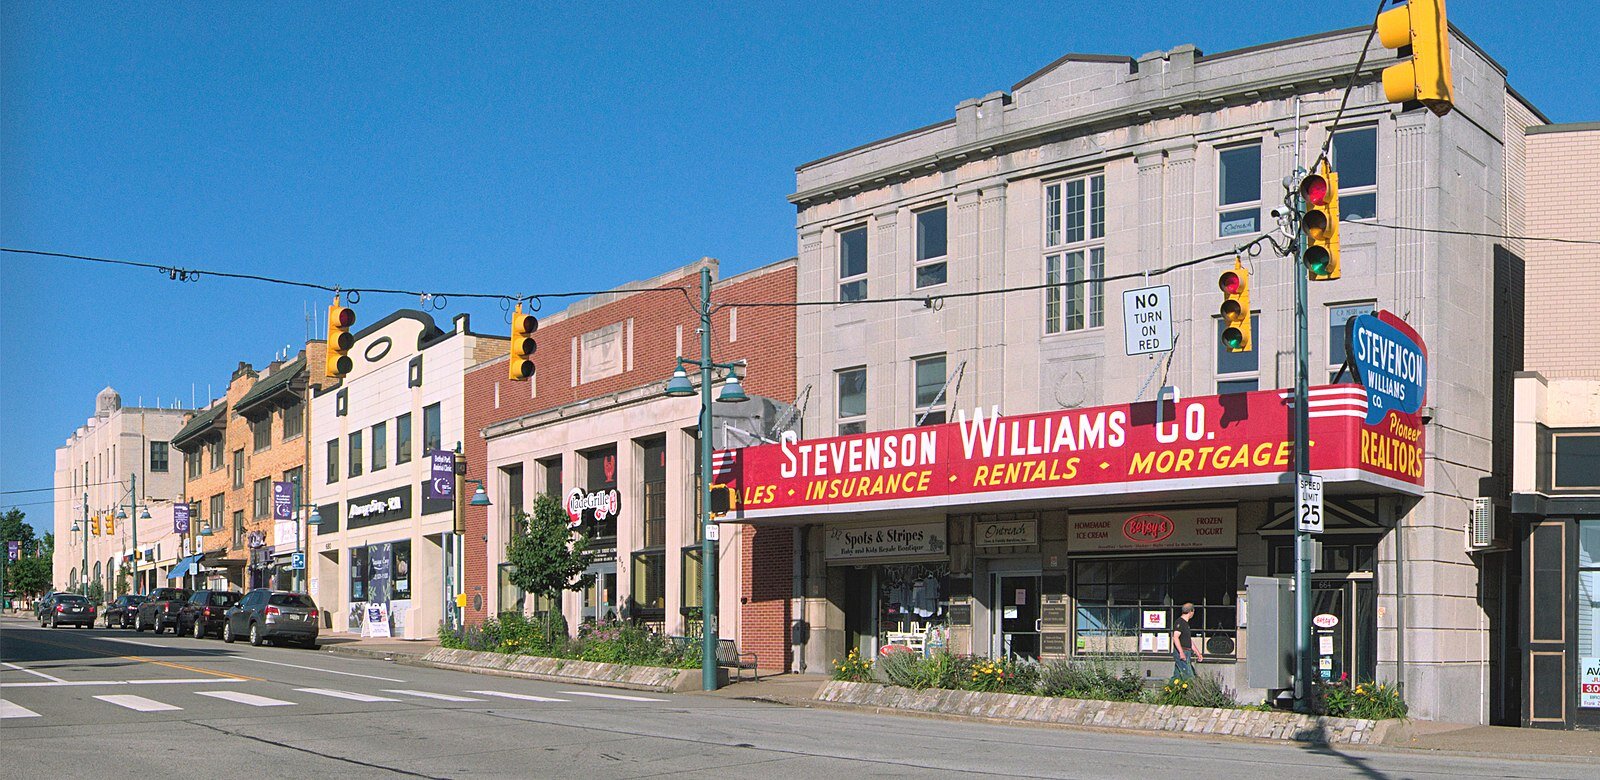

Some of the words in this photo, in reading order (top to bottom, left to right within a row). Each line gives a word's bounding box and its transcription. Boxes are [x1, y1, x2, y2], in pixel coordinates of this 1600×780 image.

[1136, 293, 1158, 309] NO
[1134, 311, 1162, 324] TURN
[1142, 325, 1156, 336] ON
[1139, 339, 1160, 350] RED
[1358, 327, 1423, 387] STEVENSON
[1367, 369, 1406, 401] WILLIAMS
[1371, 394, 1383, 409] CO.
[780, 430, 938, 478] STEVENSON
[957, 405, 1127, 460] WILLIAMS
[1156, 386, 1216, 444] CO.
[1390, 412, 1422, 442] Pioneer
[1361, 428, 1423, 478] REALTORS
[733, 485, 778, 505] ALES
[805, 471, 932, 500] INSURANCE
[974, 457, 1081, 487] RENTALS
[1128, 440, 1315, 476] MORTGAGE
[1300, 480, 1321, 491] SPEED
[1303, 492, 1319, 502] LIMIT
[1301, 504, 1321, 525] 25
[984, 523, 1026, 538] Outreach
[1074, 521, 1111, 530] HOMEMADE
[1196, 517, 1223, 525] FROZEN
[1129, 519, 1168, 539] Betsy's
[845, 530, 873, 549] Spots
[876, 530, 884, 543] &
[887, 529, 924, 546] Stripes
[1087, 531, 1109, 539] CREAM
[1195, 527, 1224, 536] YOGURT
[865, 546, 878, 554] Kids
[1318, 581, 1332, 589] 664
[1586, 667, 1600, 676] AV
